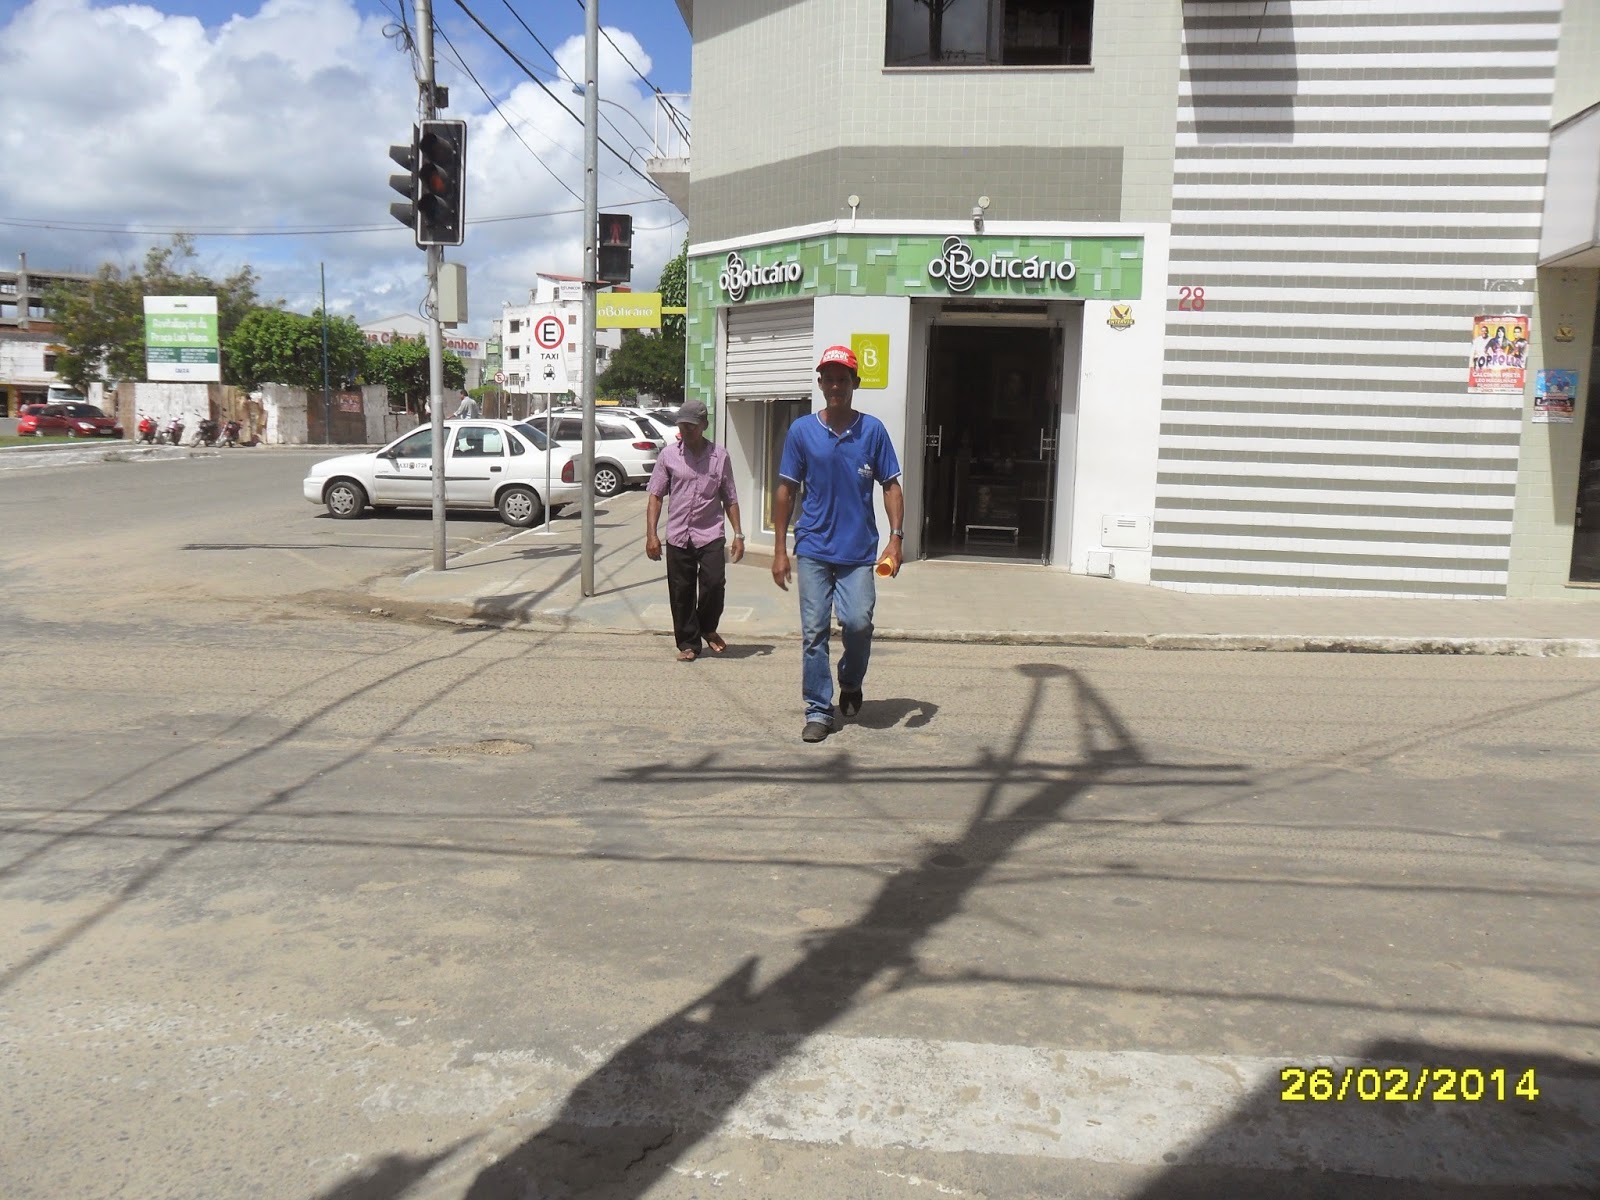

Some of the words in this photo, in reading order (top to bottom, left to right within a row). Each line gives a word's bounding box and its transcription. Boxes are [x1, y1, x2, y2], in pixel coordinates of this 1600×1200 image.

[1179, 286, 1205, 312] 28
[543, 323, 556, 342] E
[864, 348, 878, 367] B
